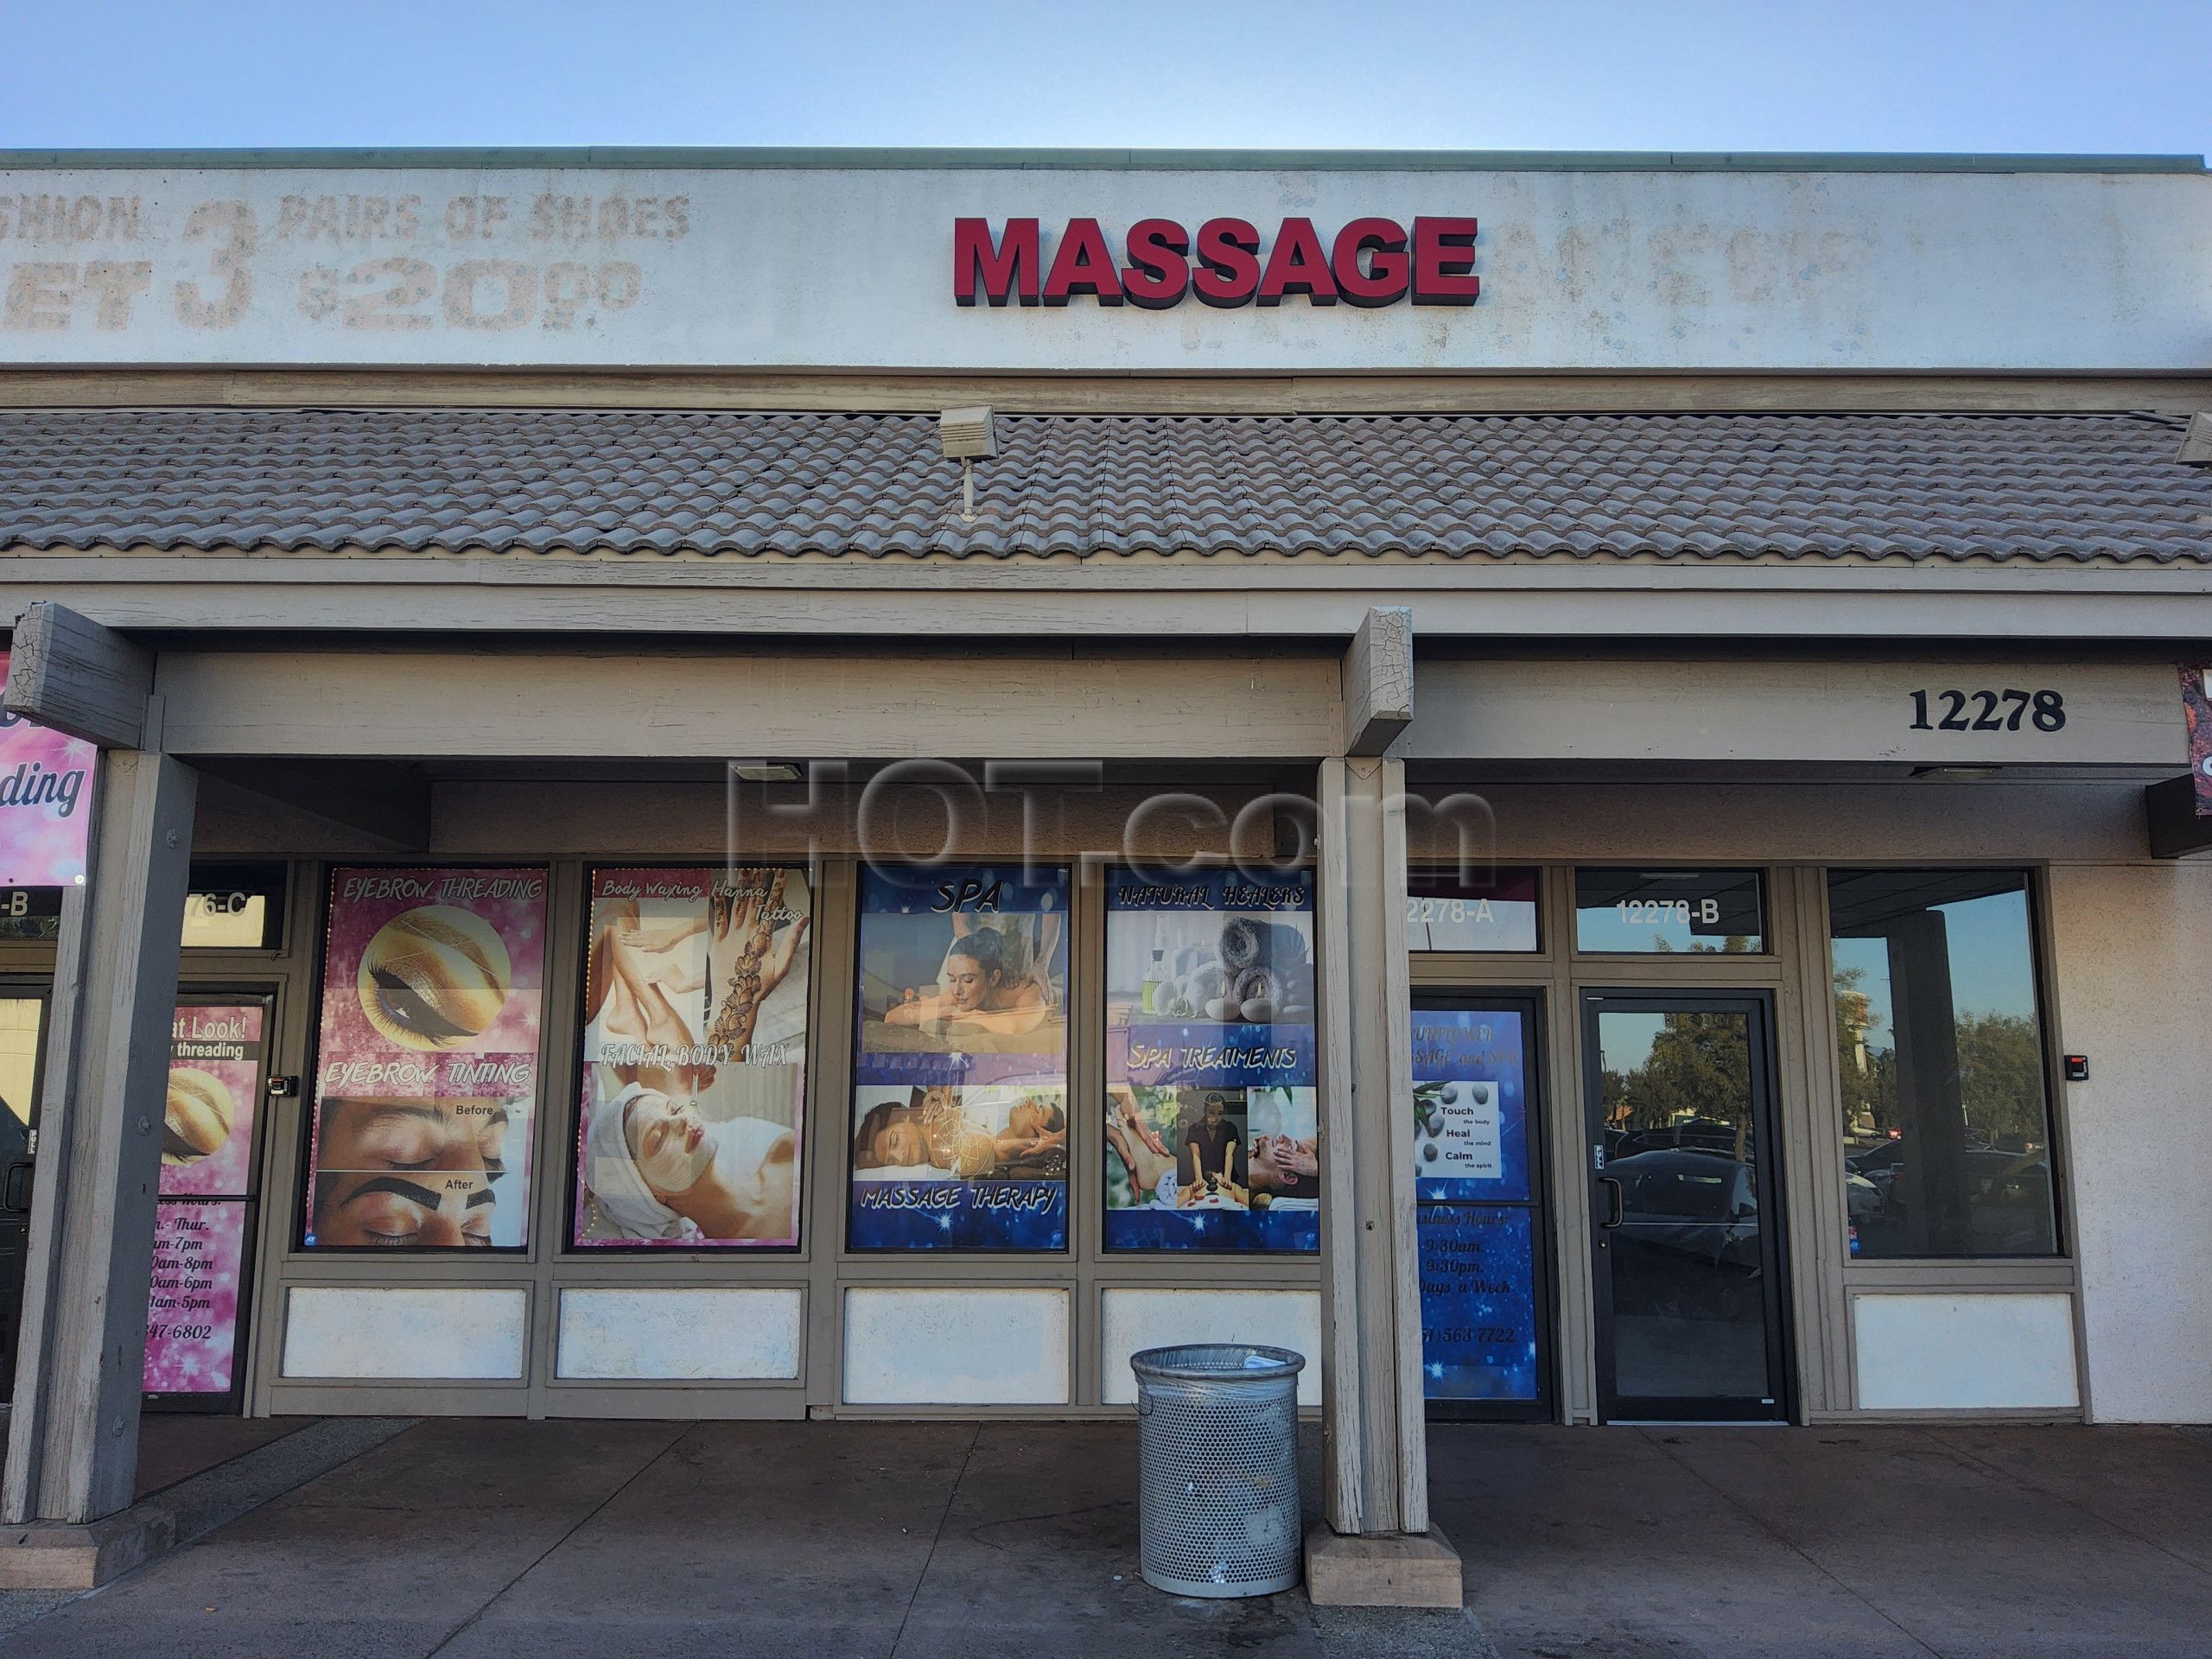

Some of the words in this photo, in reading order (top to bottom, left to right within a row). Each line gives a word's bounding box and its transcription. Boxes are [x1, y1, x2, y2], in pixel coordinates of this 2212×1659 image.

[276, 194, 423, 241] PAIRS
[444, 195, 510, 240] OF
[530, 194, 690, 241] SHOES
[175, 200, 259, 331] 3
[954, 217, 1480, 309] MASSAGE
[1910, 689, 2066, 732] 12278
[343, 876, 435, 904] EYEBROW
[441, 876, 543, 899] THREADING
[601, 879, 642, 901] Body
[645, 877, 703, 904] Waxing
[709, 879, 768, 899] Hanna
[931, 878, 1003, 913] SPA
[1118, 885, 1214, 910] NATURAL
[1223, 886, 1305, 912] HEALERS
[754, 904, 804, 922] Tattoo
[1616, 899, 1719, 924] 12278-B
[191, 1016, 247, 1039] Look!
[177, 1041, 244, 1061] threading
[601, 1043, 672, 1071] FACIAL
[676, 1043, 734, 1067] BODY
[741, 1043, 788, 1067] WAX
[1412, 1048, 1452, 1069] SAGE
[1459, 1050, 1485, 1065] and
[324, 1060, 436, 1088] EYEBROW
[447, 1062, 531, 1084] TINTING
[455, 1104, 493, 1116] Before
[1440, 1107, 1474, 1116] Touch
[1446, 1128, 1471, 1138] Heal
[1445, 1151, 1473, 1160] Calm
[445, 1179, 474, 1191] After
[861, 1185, 961, 1211] MASSAGE
[972, 1185, 1058, 1214] THERAPY
[174, 1217, 209, 1230] Thur.
[1459, 1283, 1468, 1294] a
[1471, 1279, 1512, 1294] Week
